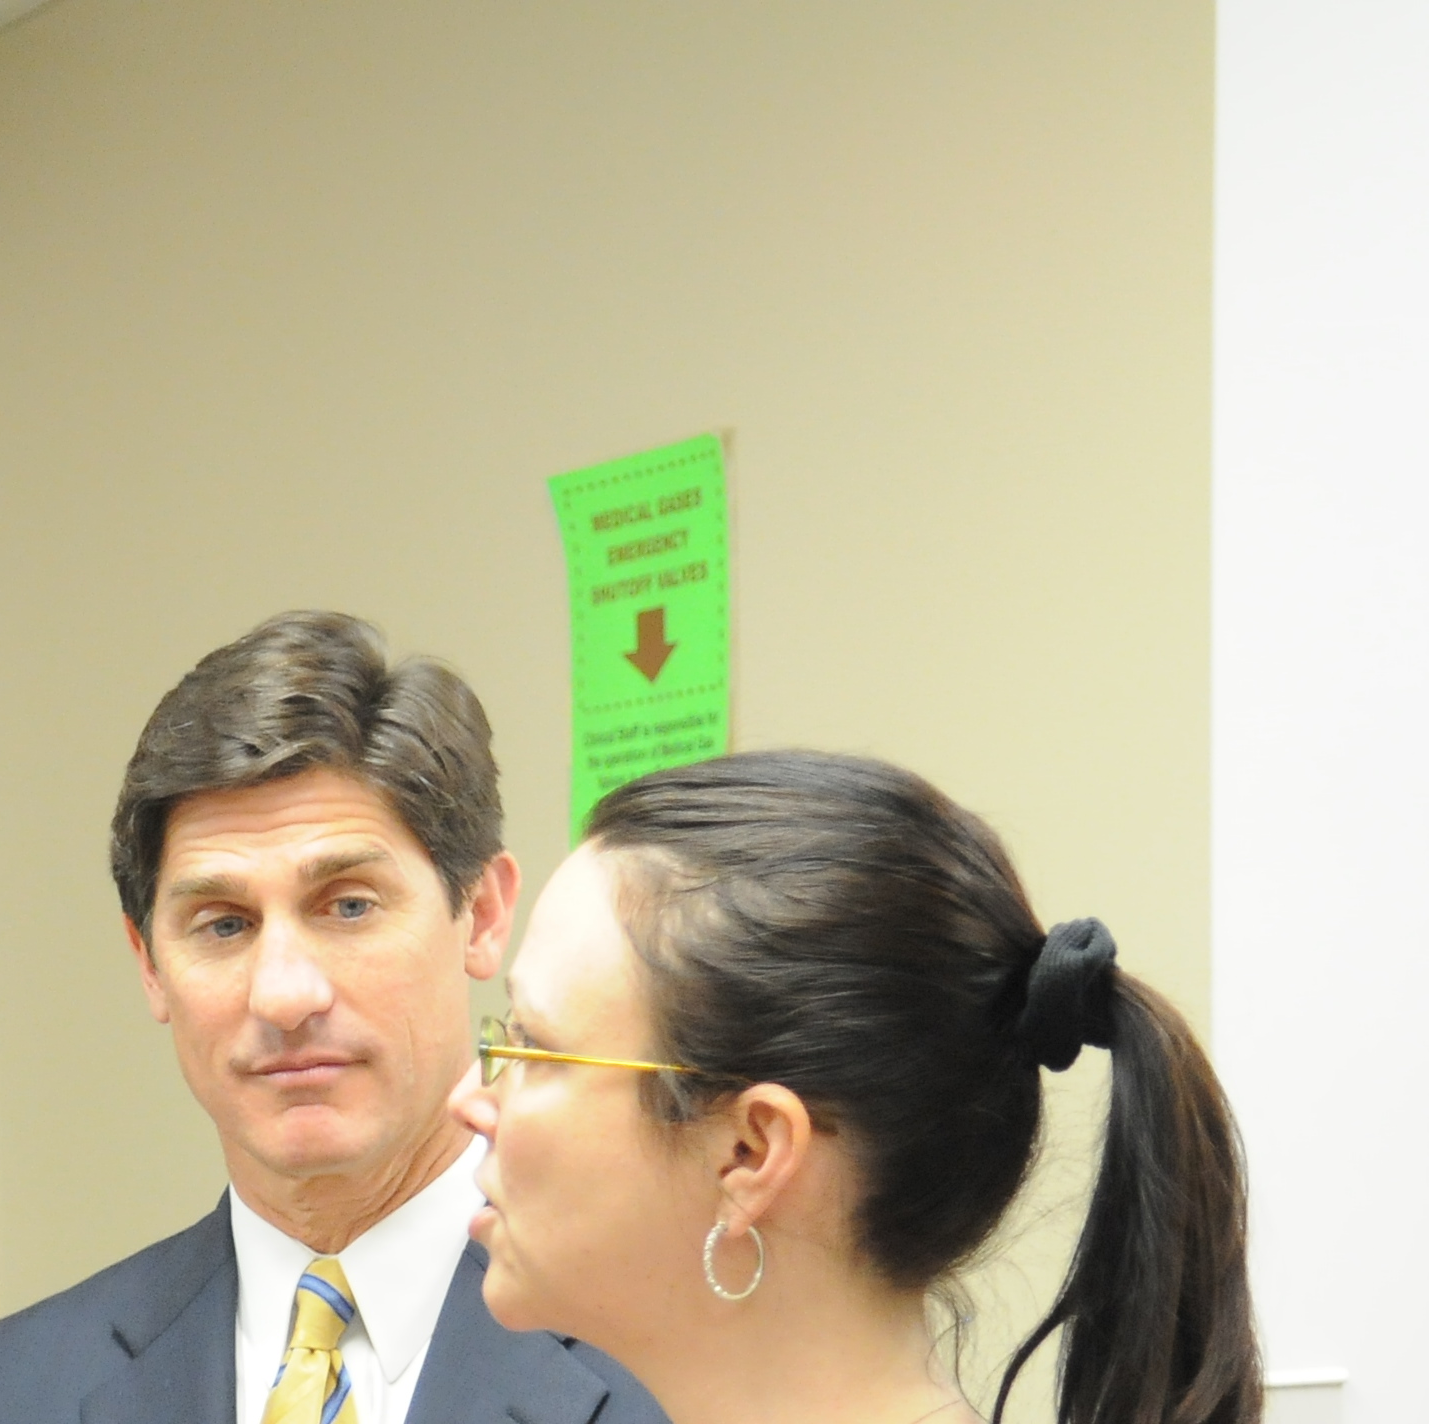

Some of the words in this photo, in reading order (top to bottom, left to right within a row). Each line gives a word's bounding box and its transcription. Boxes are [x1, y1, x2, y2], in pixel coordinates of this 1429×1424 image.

[592, 502, 653, 531] MEDICAL
[657, 486, 702, 516] GASES
[606, 528, 689, 566] EMERGENCY
[592, 573, 652, 604] SHUTOFF
[658, 561, 708, 588] VALVES
